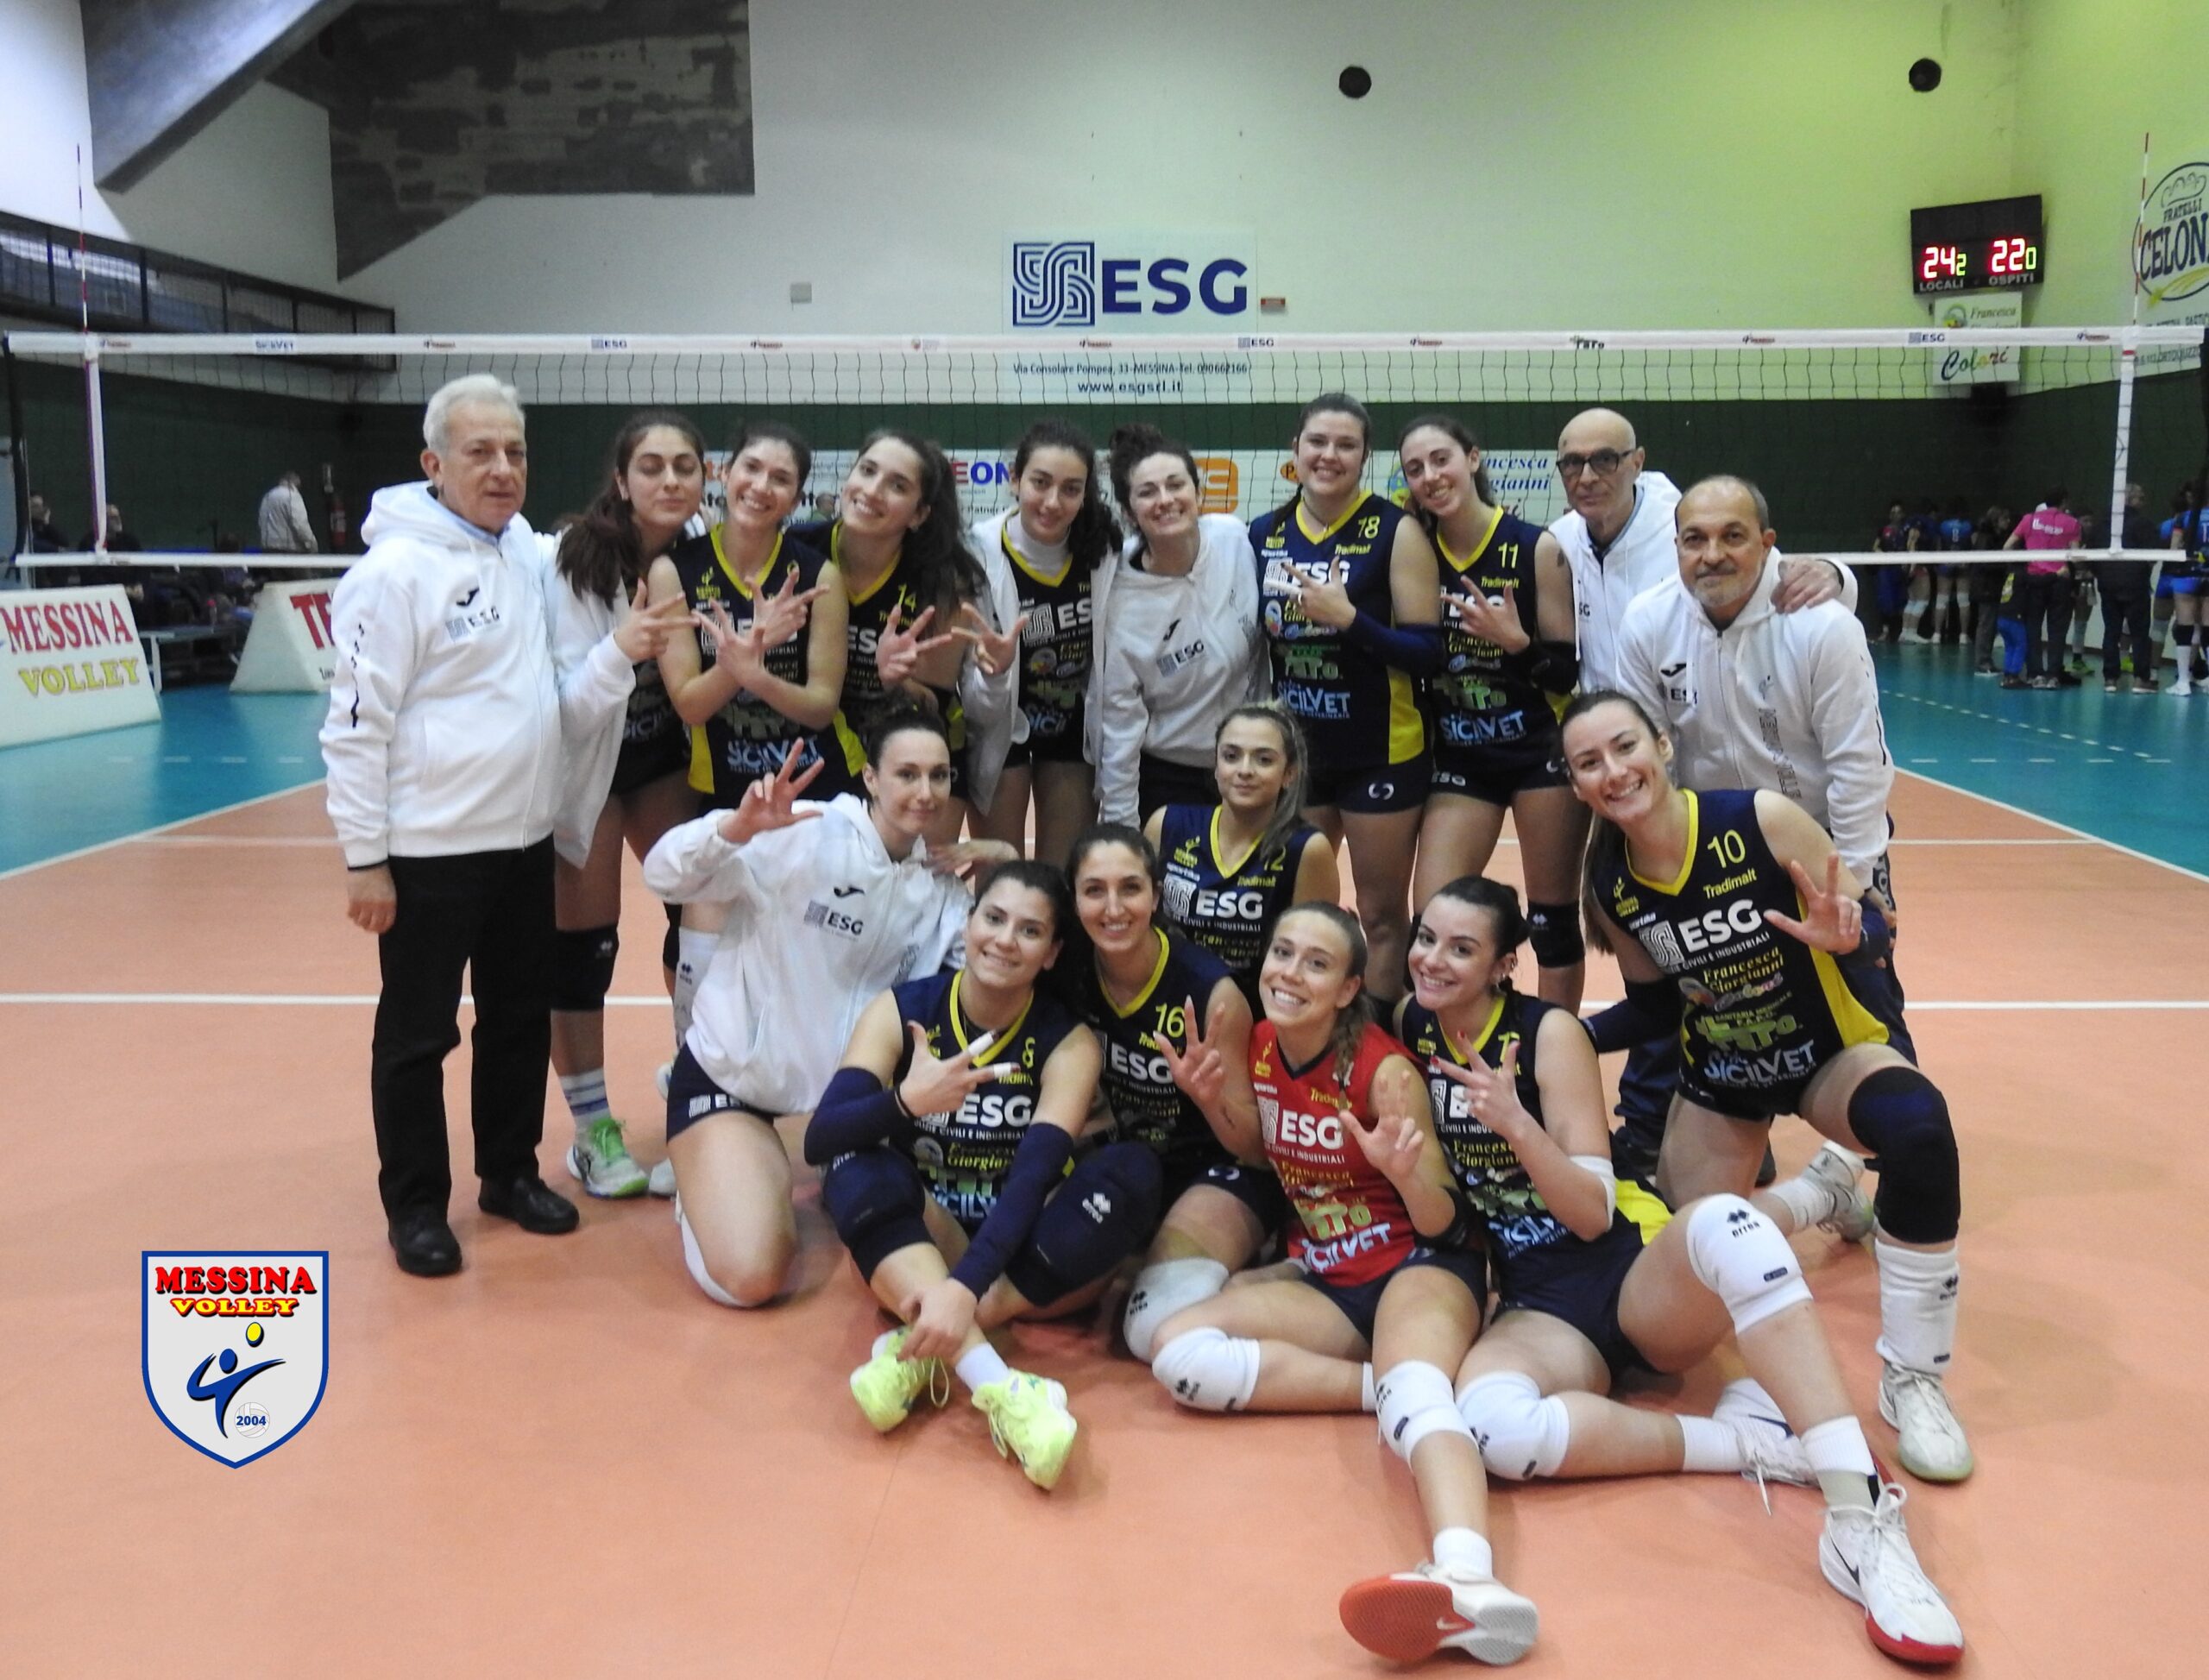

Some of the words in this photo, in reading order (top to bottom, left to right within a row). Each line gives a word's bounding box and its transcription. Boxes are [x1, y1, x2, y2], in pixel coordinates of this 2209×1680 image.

[2141, 212, 2209, 281] CELON
[1102, 258, 1248, 315] ESG
[1919, 278, 1964, 292] LOCALI
[1988, 273, 2035, 286] OSPITI
[604, 339, 627, 349] ESG
[1251, 337, 1274, 347] ESG
[1922, 334, 1945, 343] ESG
[1013, 363, 1028, 374] Via
[1030, 363, 1074, 374] Consolare
[1078, 381, 1183, 396] www.esgsrl.it
[1486, 456, 1548, 470] ncesca
[1357, 515, 1381, 539] 18
[1498, 542, 1520, 569] 11
[898, 583, 917, 613] 14
[0, 597, 134, 655] MESSINA
[1057, 597, 1092, 631] ES
[18, 657, 142, 697] VOLLEY
[1707, 829, 1746, 868] 10
[1702, 867, 1758, 899] Tradimalt
[1195, 888, 1263, 920] ESG
[828, 911, 864, 935] ESG
[1677, 898, 1763, 953] ESG
[1714, 931, 1771, 959] INDUSTRIALI
[1703, 947, 1780, 984] Francesca
[1155, 1003, 1186, 1038] 16
[1111, 1042, 1174, 1085] ESG
[955, 1093, 1033, 1129] ESG
[976, 1130, 1024, 1141] INDUSTRIAL
[1281, 1109, 1344, 1150] ESG
[1297, 1150, 1345, 1165] INDUSTRIALI
[1453, 1139, 1512, 1154] Frances
